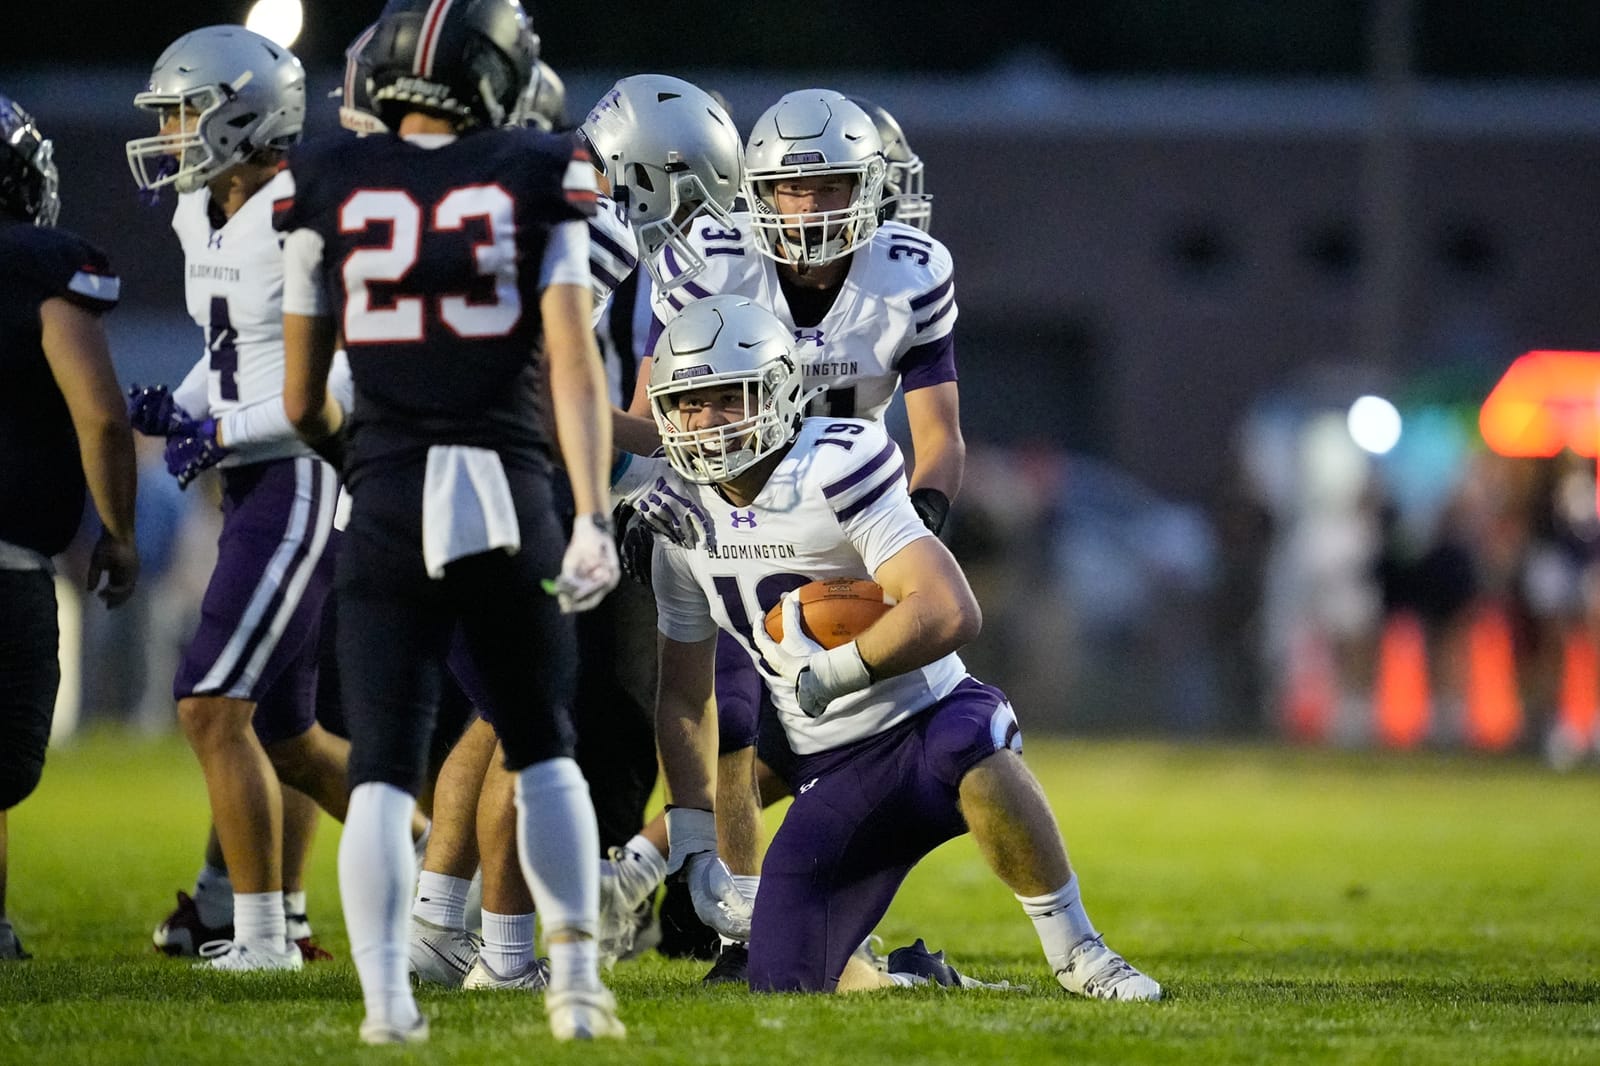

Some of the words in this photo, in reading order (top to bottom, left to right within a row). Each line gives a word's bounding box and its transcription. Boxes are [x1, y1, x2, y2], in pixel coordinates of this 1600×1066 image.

[701, 227, 745, 257] 31
[889, 233, 932, 266] 31
[337, 183, 522, 343] 23
[210, 296, 241, 402] 4
[814, 423, 865, 451] 19
